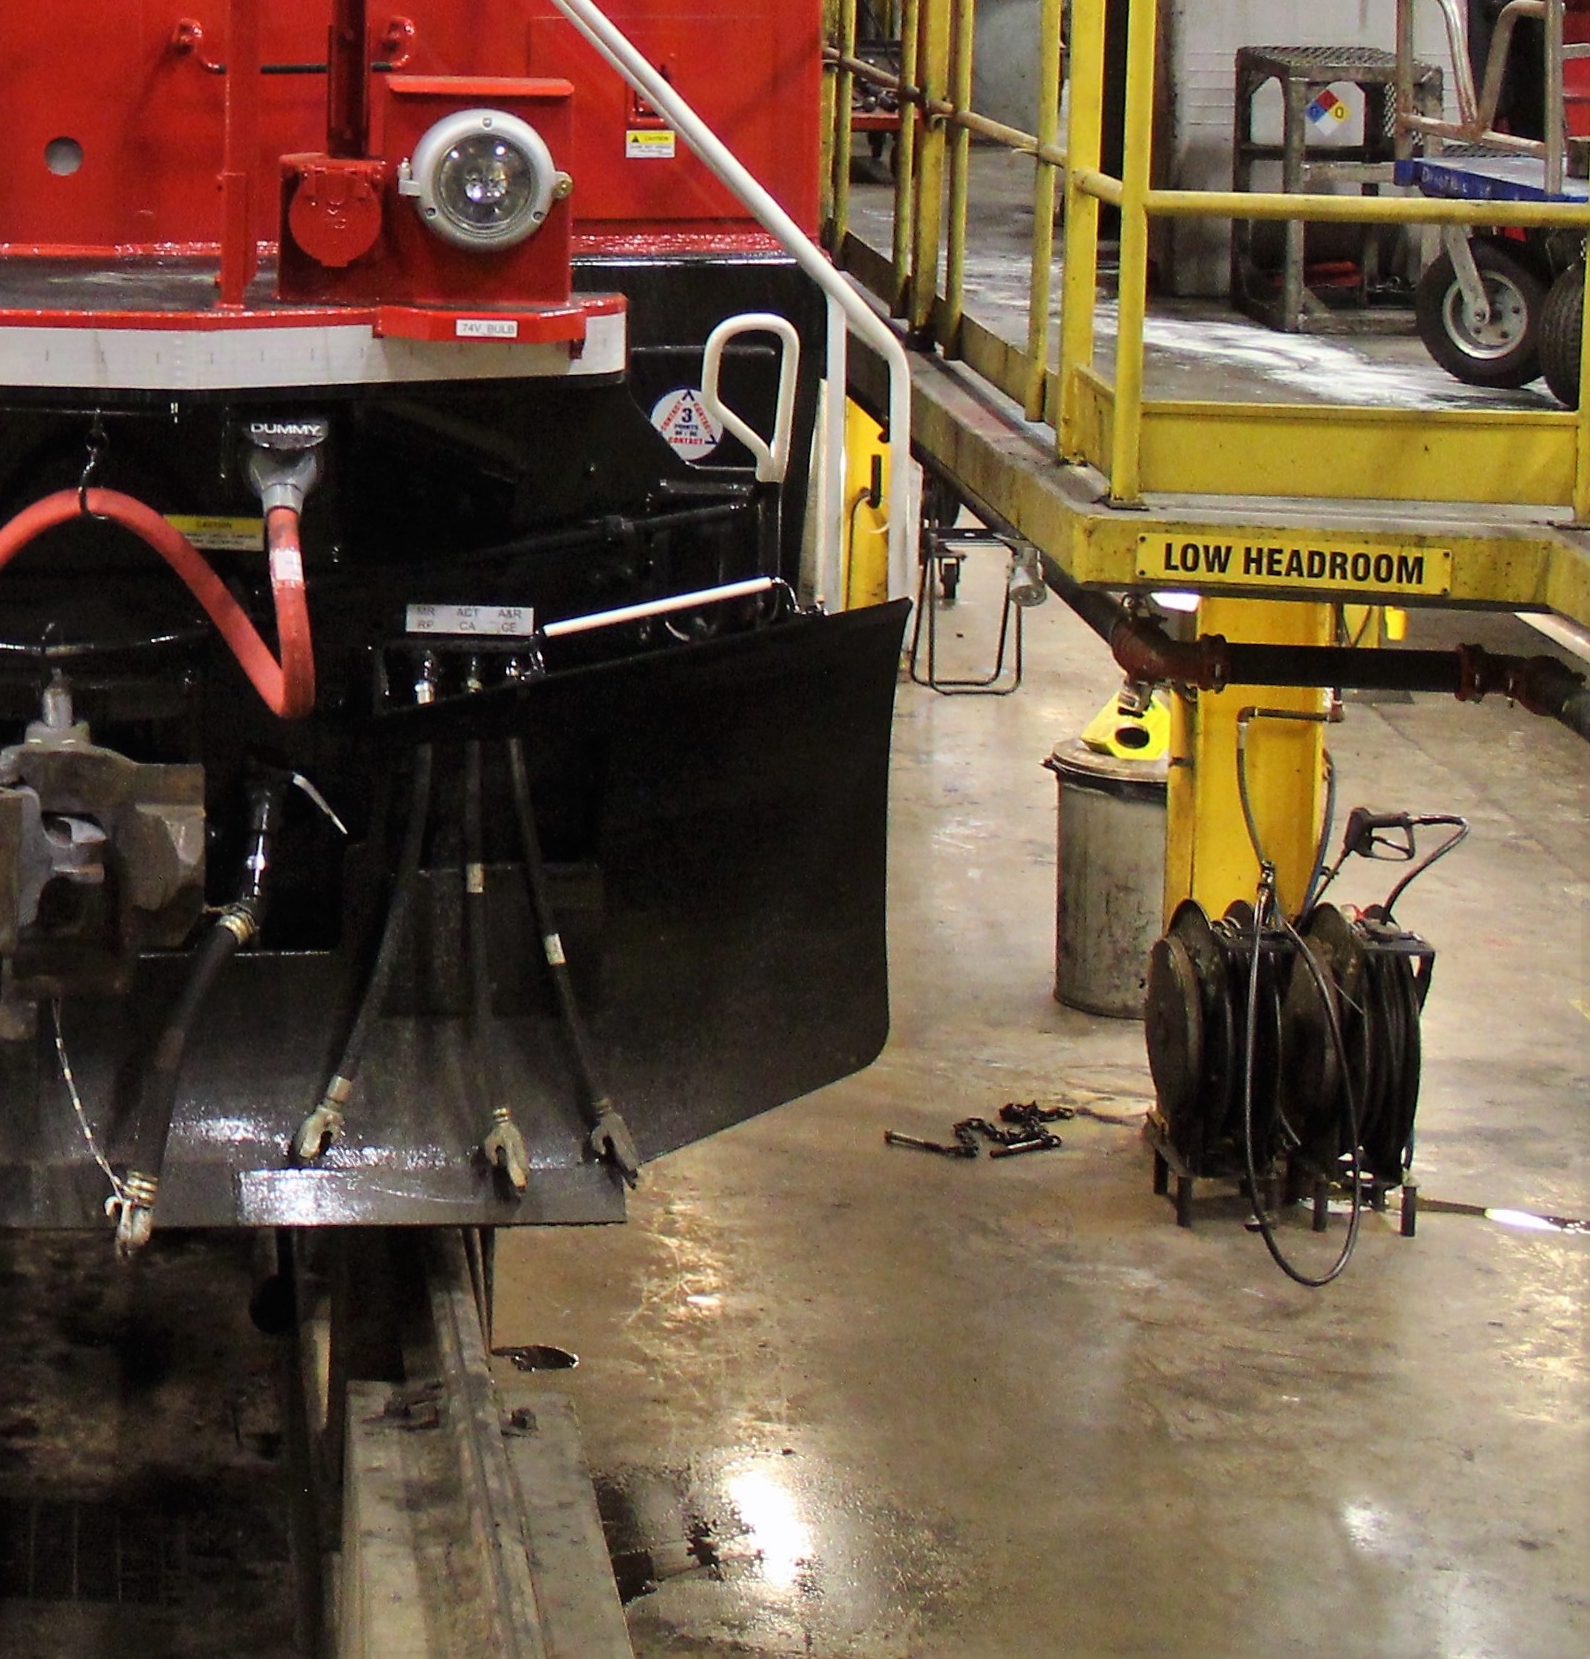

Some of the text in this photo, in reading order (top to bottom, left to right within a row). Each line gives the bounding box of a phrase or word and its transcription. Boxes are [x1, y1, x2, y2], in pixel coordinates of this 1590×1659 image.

[1334, 106, 1345, 119] 0
[463, 323, 515, 334] 74V BULB
[681, 407, 693, 423] 3
[250, 422, 321, 435] DUMMY
[1163, 542, 1426, 585] LOW HEADROOM
[457, 608, 479, 618] ACT
[498, 609, 522, 619] A&R
[459, 621, 476, 631] CA
